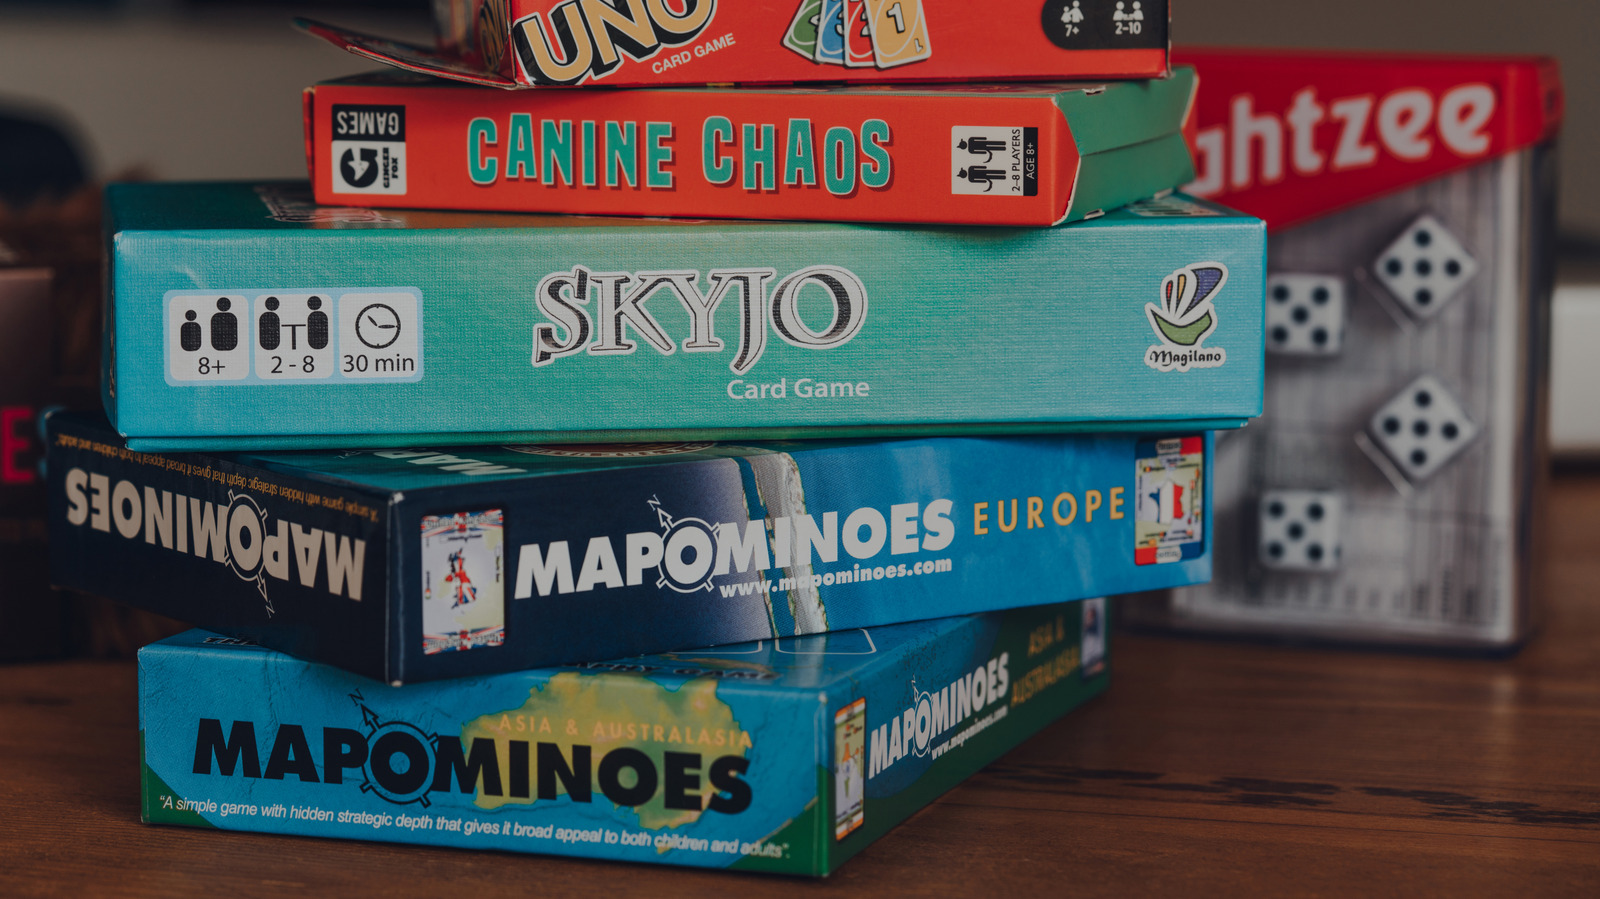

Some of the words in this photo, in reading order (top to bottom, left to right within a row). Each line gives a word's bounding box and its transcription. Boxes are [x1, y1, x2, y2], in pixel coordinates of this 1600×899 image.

[1065, 24, 1080, 37] 7+
[1115, 22, 1142, 35] 2-10
[651, 50, 692, 74] CARD
[694, 33, 736, 60] GAME
[337, 111, 399, 135] GAMES
[467, 113, 674, 191] CANINE
[702, 115, 893, 197] CHAOS
[1012, 129, 1021, 172] PLAYERS
[1026, 142, 1035, 155] 8+
[1026, 157, 1035, 180] AGE
[532, 265, 868, 375] SKYJO
[198, 357, 225, 375] 8+
[343, 354, 369, 373] 30
[375, 353, 415, 372] min
[1150, 350, 1222, 367] Magilano
[727, 378, 786, 400] Card
[794, 378, 870, 399] Game
[119, 446, 134, 463] both
[135, 452, 142, 463] to
[142, 451, 166, 469] appeal
[166, 459, 186, 476] broad
[186, 464, 192, 477] it
[192, 465, 212, 481] gives
[212, 469, 225, 484] that
[226, 473, 247, 489] depth
[248, 476, 278, 495] strategic
[279, 487, 304, 505] hidden
[305, 493, 321, 507] with
[322, 496, 344, 511] game
[973, 486, 1125, 536] EUROPE
[65, 467, 366, 602] MAPOMINOES
[514, 498, 956, 600] MAPOMINOES
[719, 558, 953, 599] www.mapominoes.com
[868, 651, 1009, 780] MAPOMINOES
[500, 714, 552, 734] ASIA
[566, 718, 579, 736] &
[593, 720, 753, 749] AUSTRALASIA
[192, 717, 753, 815] MAPOMINOES
[176, 797, 217, 814] simple
[220, 803, 258, 817] game
[261, 803, 287, 818] with
[290, 805, 334, 821] hidden
[337, 809, 392, 828] strategic
[395, 813, 433, 831] depth
[436, 816, 462, 832] that
[464, 819, 500, 836] gives
[502, 821, 511, 835] it
[513, 822, 553, 839] broad
[555, 828, 602, 843] appeal
[604, 829, 618, 844] to
[621, 830, 651, 847] both
[654, 833, 708, 851] children
[710, 839, 739, 854] and
